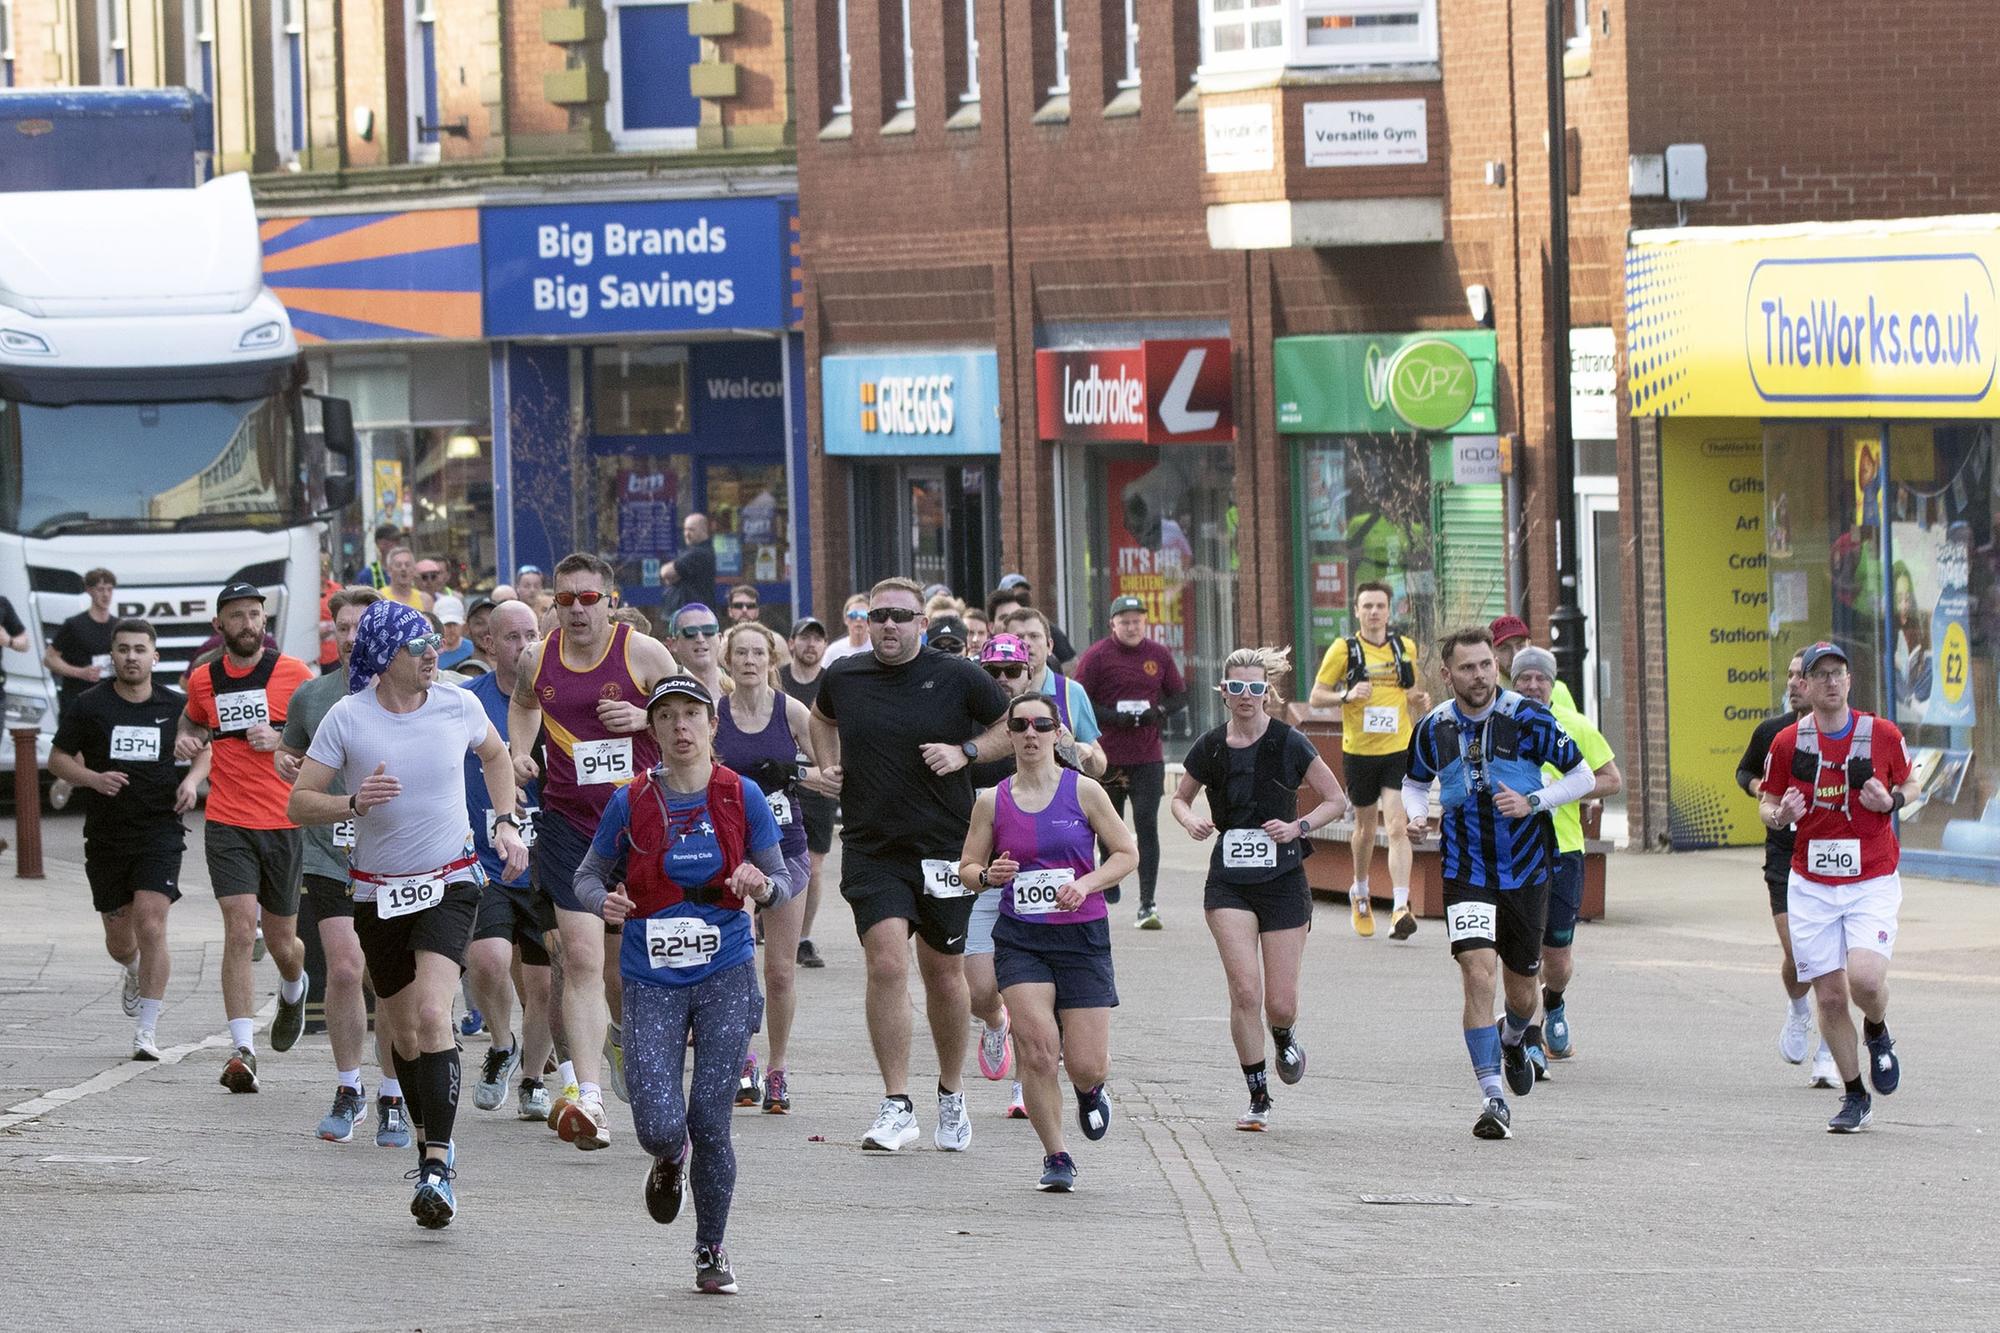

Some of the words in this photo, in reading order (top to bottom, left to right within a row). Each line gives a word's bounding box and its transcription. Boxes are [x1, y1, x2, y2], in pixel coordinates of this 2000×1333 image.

[1348, 111, 1375, 123] The
[1316, 130, 1379, 142] Versatile
[1383, 128, 1417, 143] Gym
[538, 223, 594, 266] Big
[605, 217, 727, 256] Brands
[533, 275, 589, 318] Big
[600, 271, 735, 314] Savings
[1761, 292, 1981, 368] TheWorks.co.uk
[1405, 366, 1466, 398] VPZ
[877, 375, 953, 434] GREGGS
[1460, 447, 1499, 462] IQO
[1728, 477, 1765, 493] Gifts
[1736, 514, 1760, 531] Art
[1732, 588, 1768, 608] Toys
[117, 600, 207, 618] DAF
[1946, 653, 1963, 684] £2
[219, 703, 267, 722] 2286
[1370, 715, 1394, 727] 272
[115, 738, 157, 752] 1374
[583, 753, 626, 774] 945
[699, 851, 713, 860] Club
[1231, 842, 1268, 858] 239
[1815, 853, 1853, 868] 240
[388, 884, 433, 909] 190
[1017, 885, 1064, 904] 100
[1455, 914, 1490, 930] 622
[650, 934, 719, 958] 2243
[448, 1062, 460, 1107] 2XU
